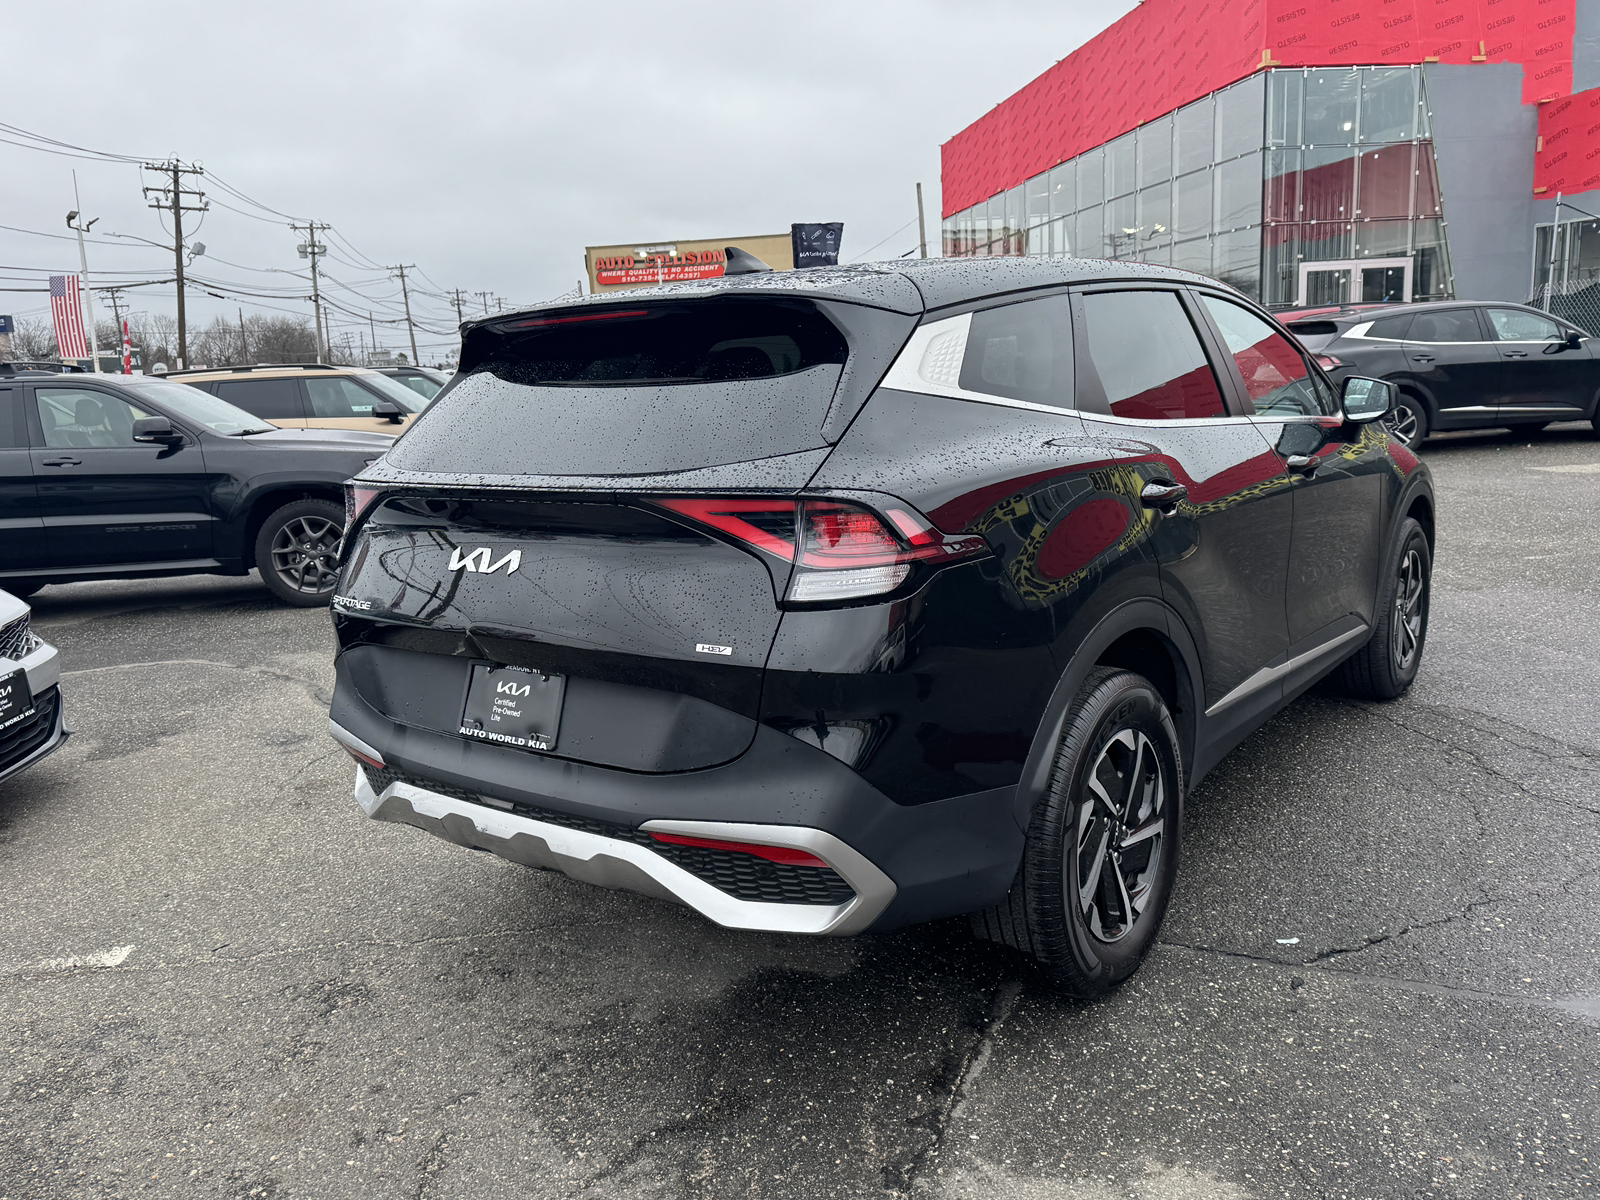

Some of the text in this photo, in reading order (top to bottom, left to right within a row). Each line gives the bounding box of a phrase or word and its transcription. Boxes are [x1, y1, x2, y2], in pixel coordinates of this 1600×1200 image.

[1277, 8, 1306, 23] RESISTO
[1331, 12, 1360, 28] RESISTO
[1383, 13, 1413, 29] RESISTO
[1435, 14, 1464, 30] RESISTO
[1487, 14, 1516, 30] RESISTO
[1538, 14, 1566, 30] RESISTO
[1277, 33, 1307, 48] RESISTO
[1329, 40, 1358, 55] RESISTO
[1381, 41, 1410, 57] RESISTO
[1433, 42, 1462, 57] RESISTO
[1535, 42, 1563, 57] RESISTO
[1535, 65, 1563, 81] RESISTO
[1548, 101, 1572, 119] RESISTO
[1545, 127, 1569, 145] RESISTO
[1544, 151, 1568, 169] RESISTO
[595, 250, 725, 270] AUTO COLLISION
[628, 268, 658, 276] QUALITY
[684, 264, 719, 273] ACCIDENT
[448, 546, 522, 576] KIA
[333, 595, 371, 610] SPORTAGE
[702, 645, 727, 653] HEV
[497, 681, 530, 697] KIA
[494, 698, 516, 708] Certified
[491, 713, 500, 722] Lite
[492, 706, 521, 717] Pre-Owned
[459, 727, 487, 738] AUTO
[488, 733, 526, 746] WORLD
[528, 740, 548, 751] KIA
